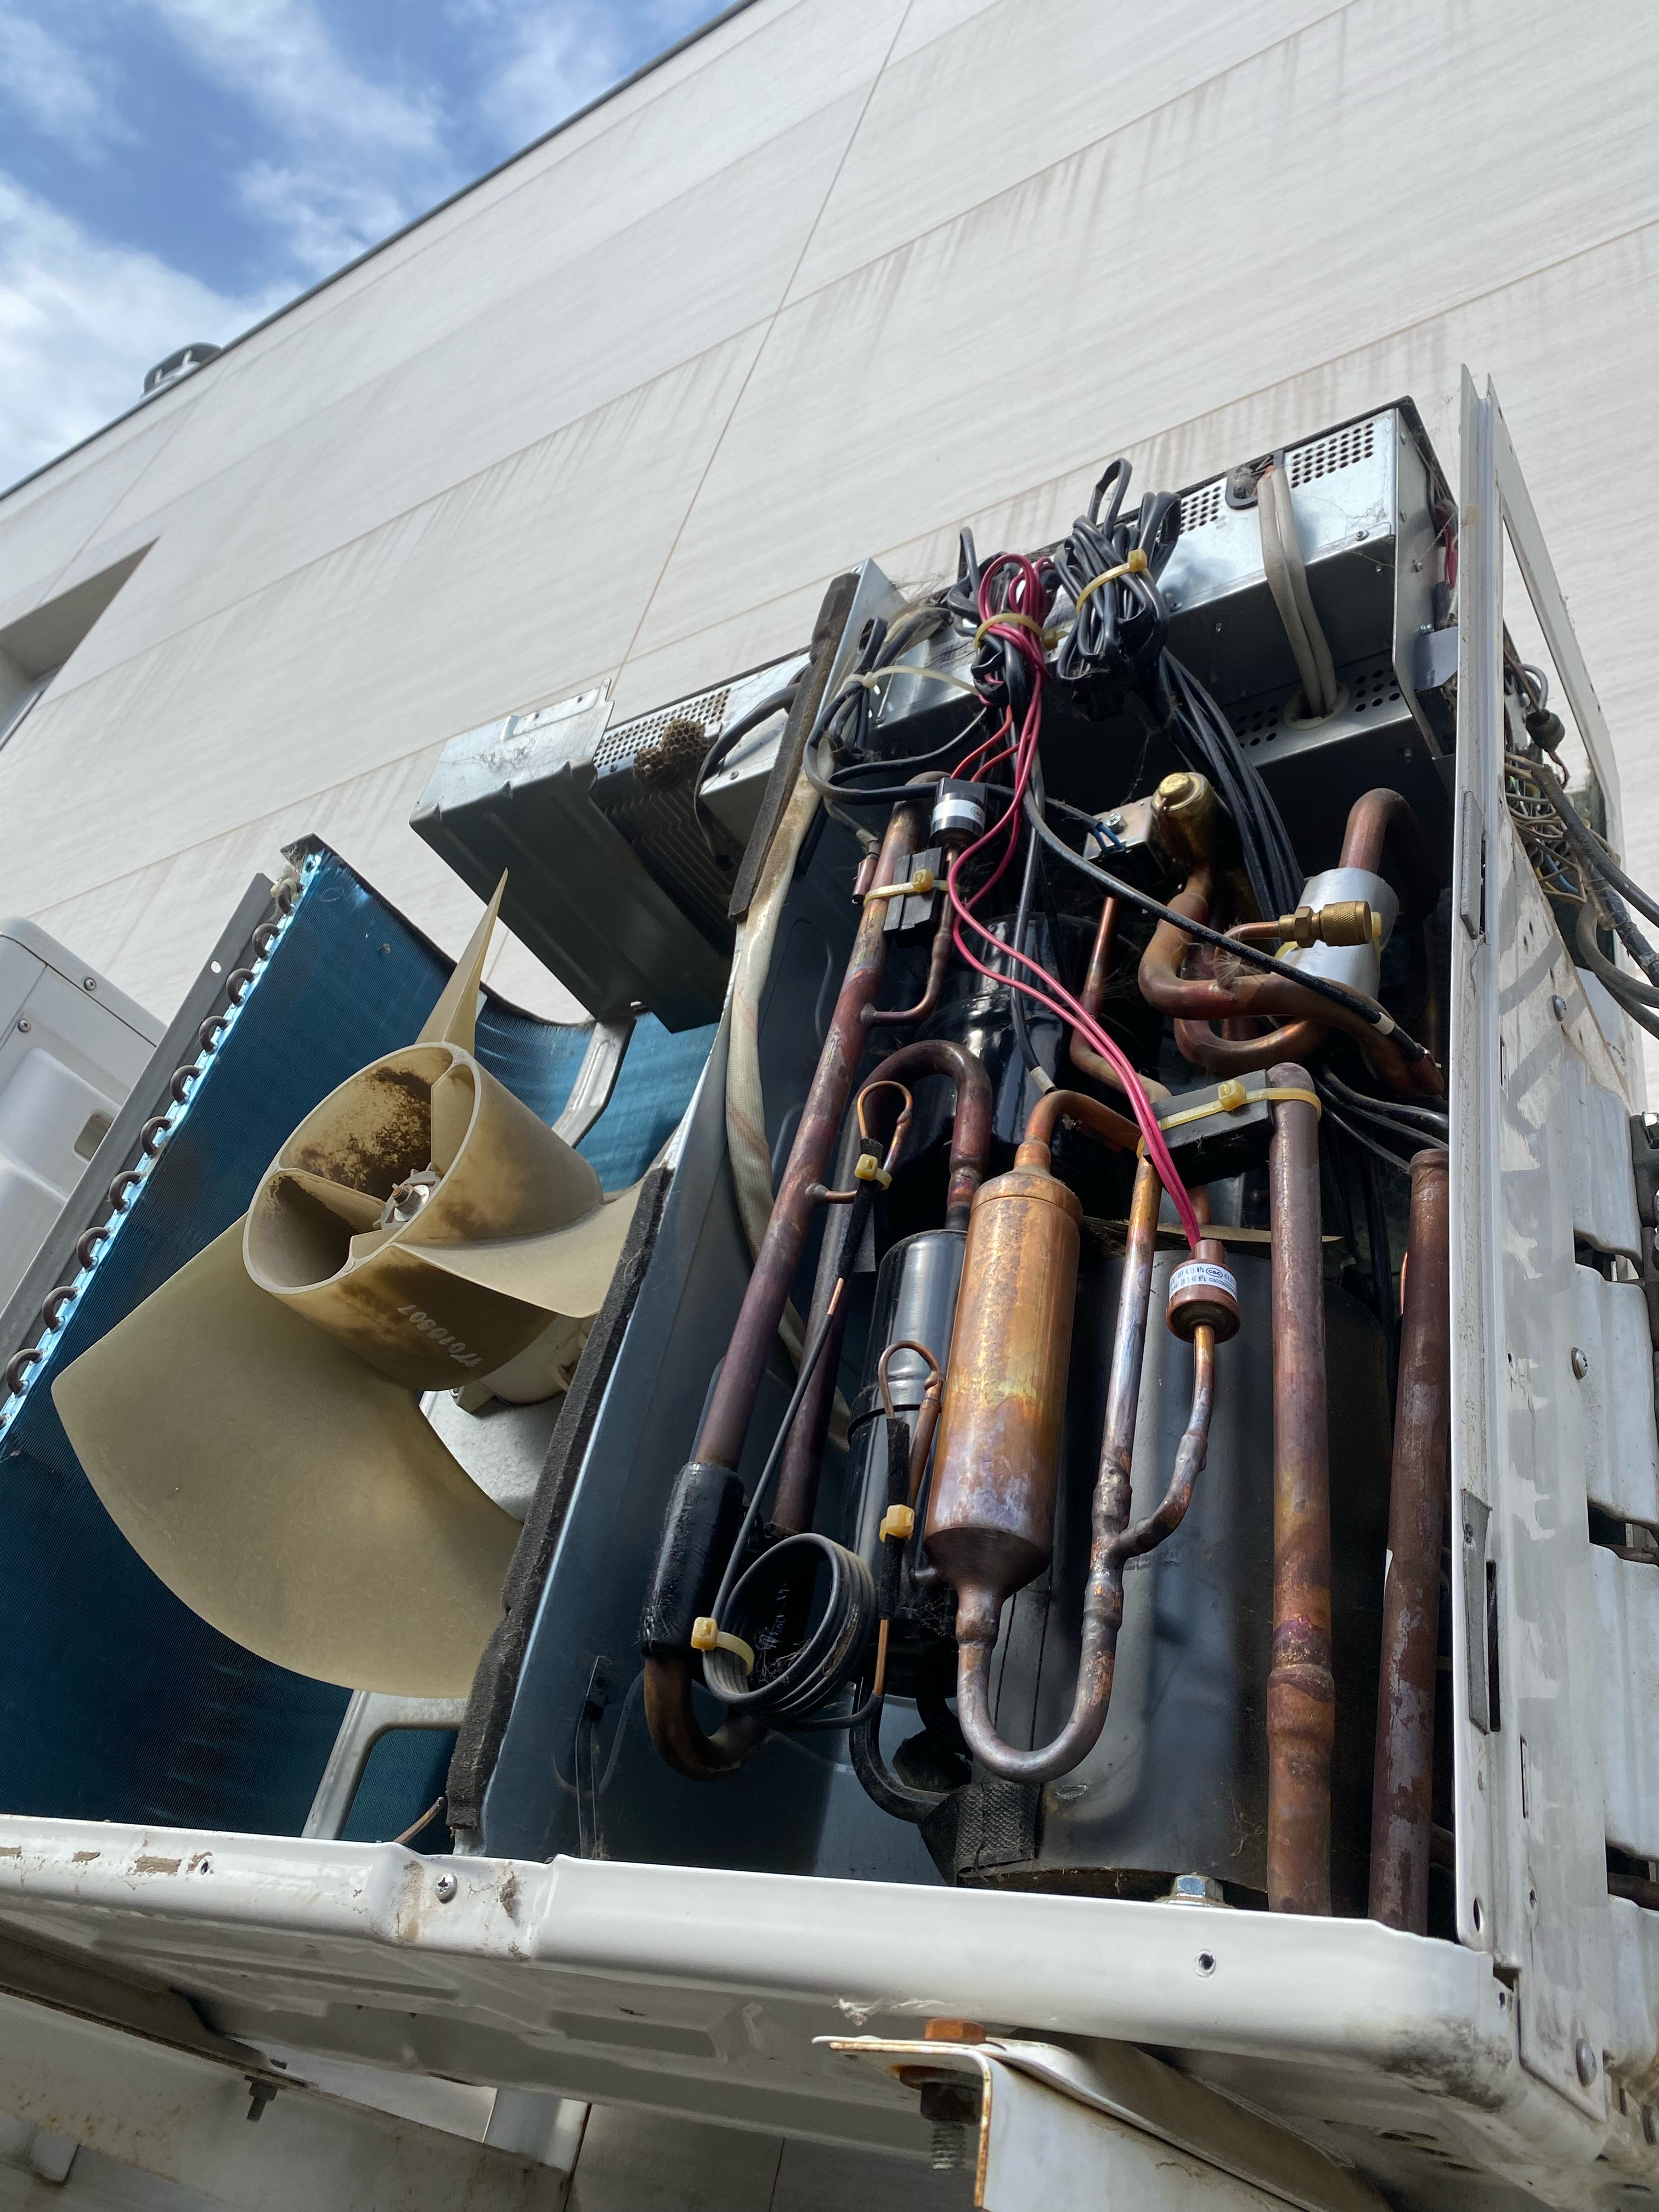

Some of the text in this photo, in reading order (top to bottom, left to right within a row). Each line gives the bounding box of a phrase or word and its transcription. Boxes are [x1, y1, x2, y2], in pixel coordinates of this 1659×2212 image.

[1167, 913, 1198, 931] PUSHENG
[1245, 950, 1265, 961] 600V
[1323, 985, 1342, 995] 600V
